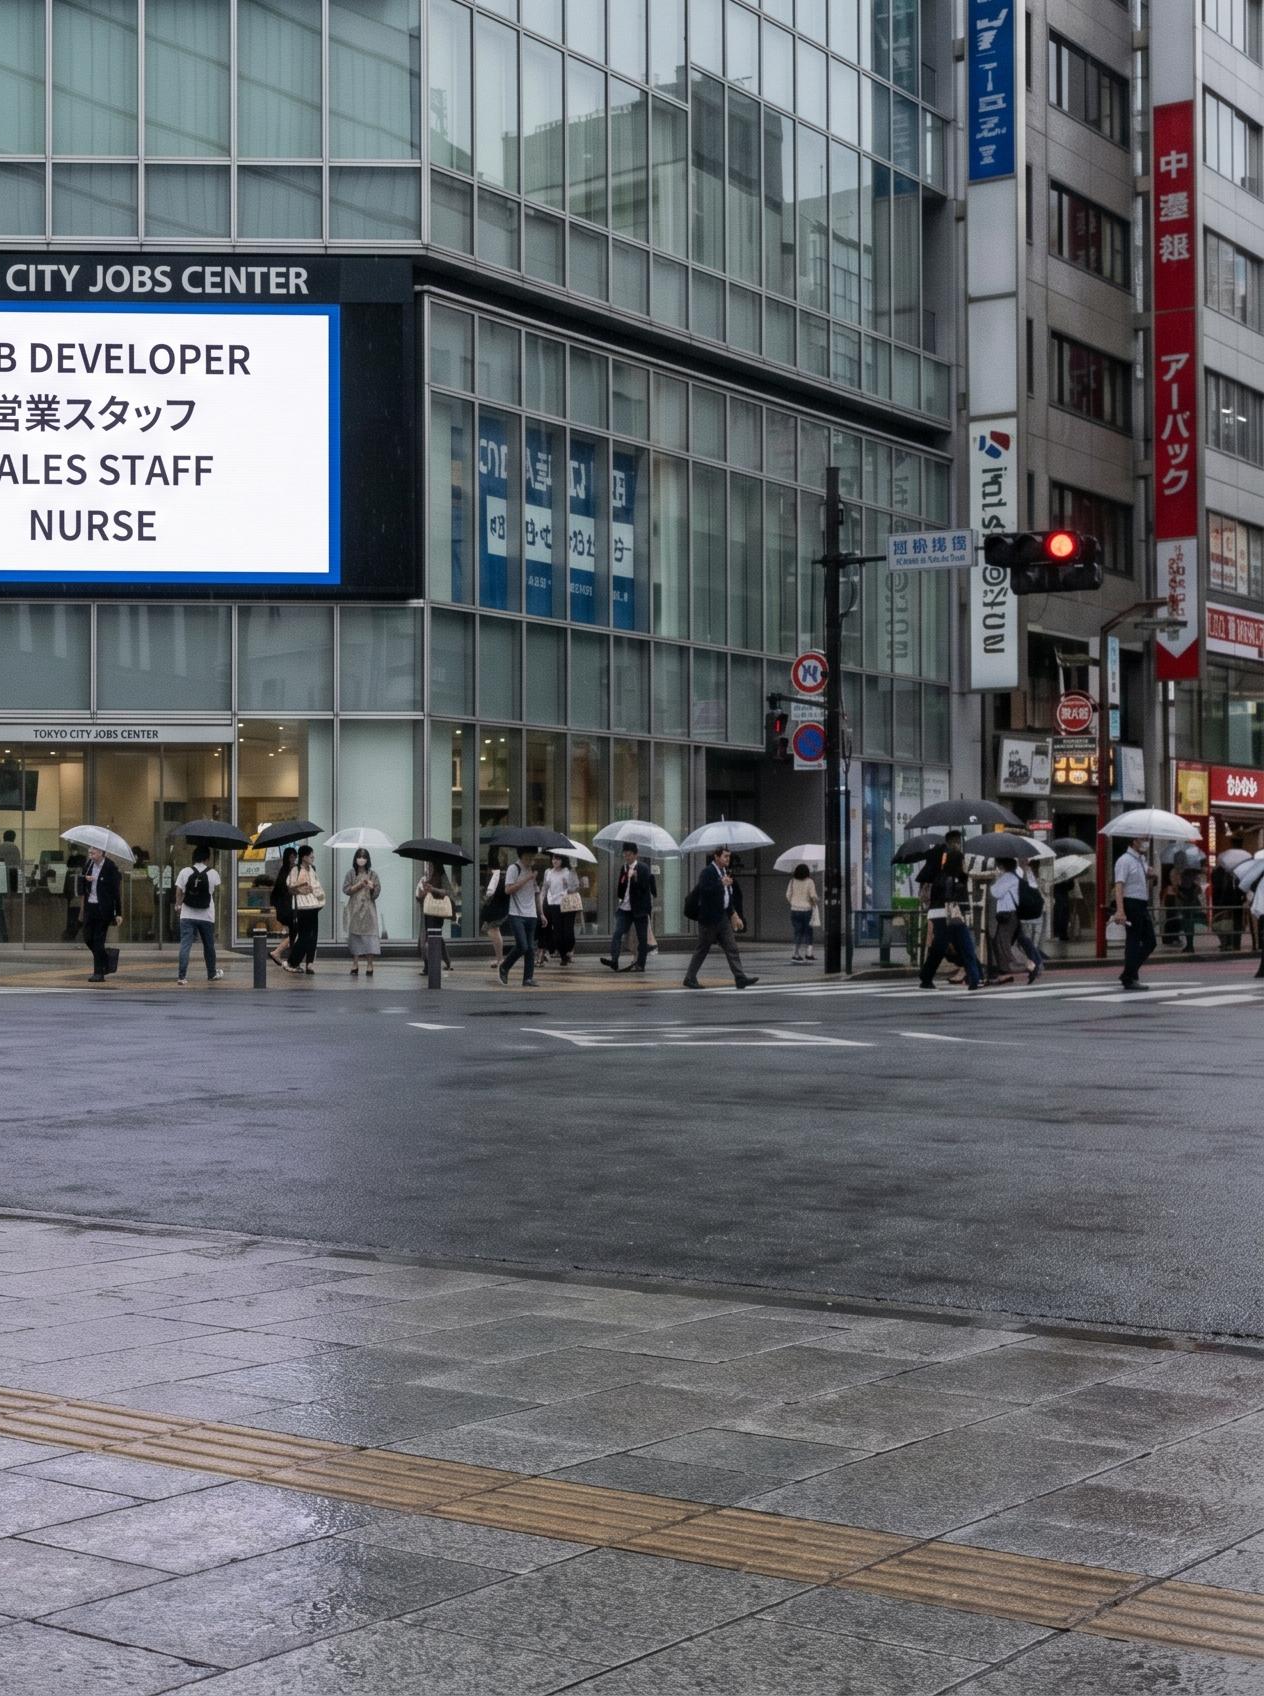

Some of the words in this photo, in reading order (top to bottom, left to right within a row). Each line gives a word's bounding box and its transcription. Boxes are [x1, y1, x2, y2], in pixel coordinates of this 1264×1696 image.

[5, 263, 81, 293] CITY
[88, 264, 173, 294] JOBS
[181, 265, 309, 295] CENTER
[29, 342, 251, 376] DEVELOPER
[1161, 352, 1191, 496] アーバック
[98, 454, 214, 486] STAFF
[29, 509, 158, 542] NURSE
[33, 729, 68, 739] TOKYO
[69, 729, 92, 739] CITY
[93, 729, 118, 740] JOBS
[120, 729, 159, 740] CENTER
